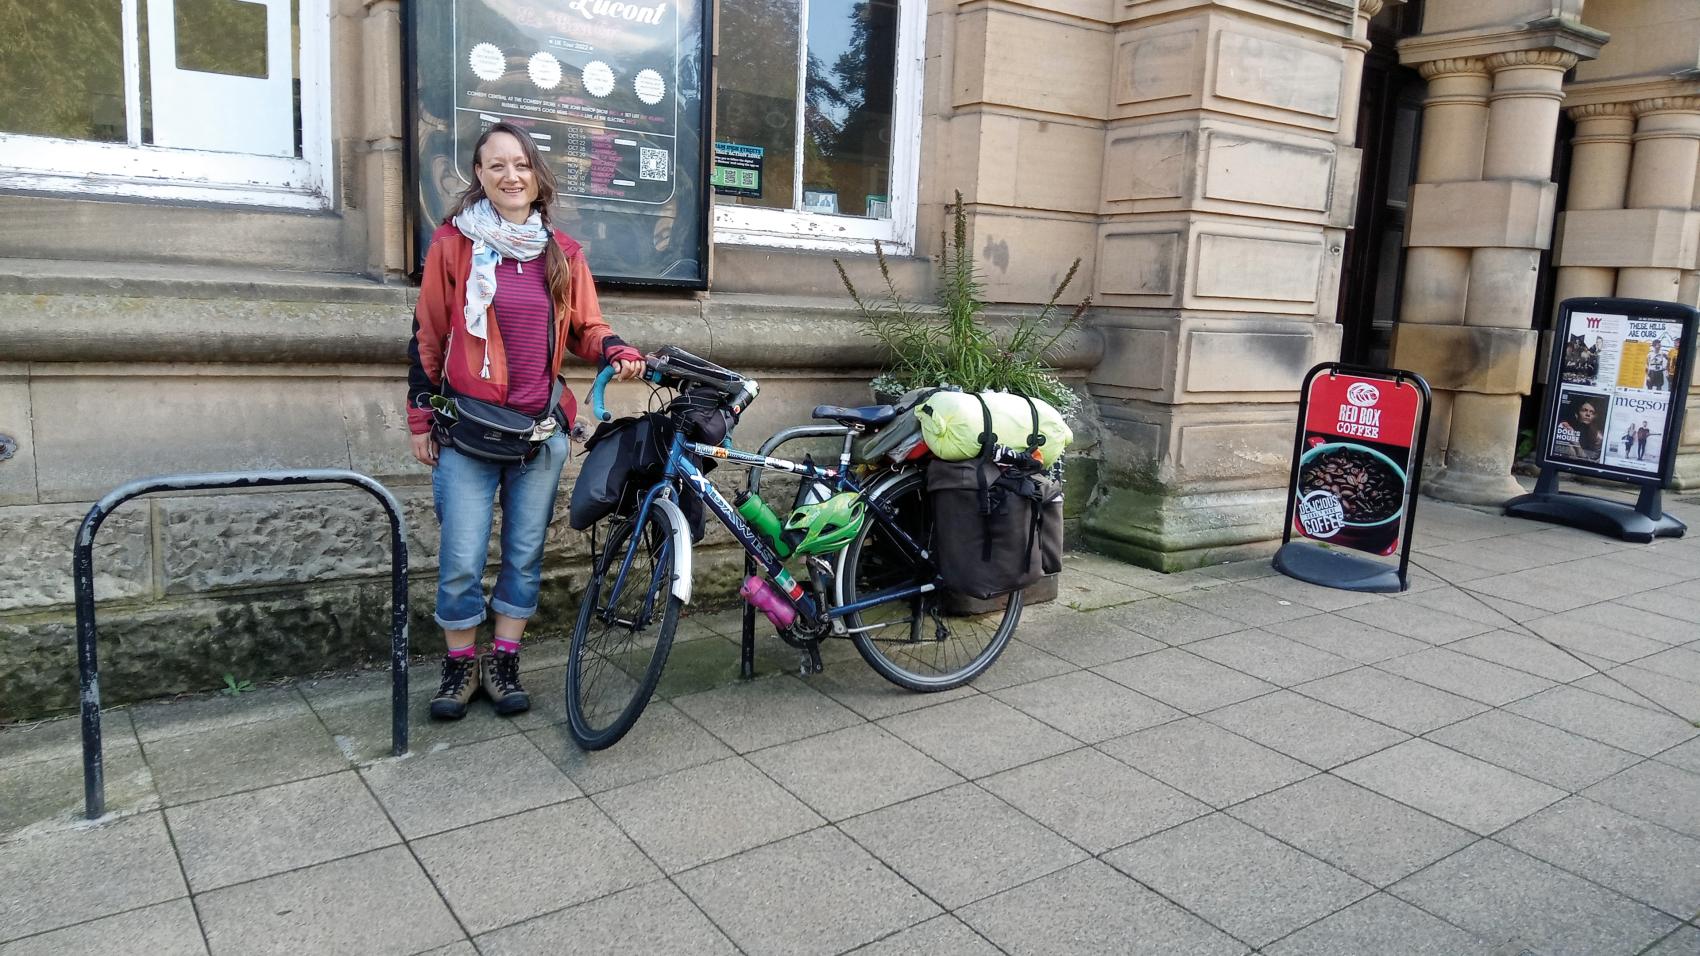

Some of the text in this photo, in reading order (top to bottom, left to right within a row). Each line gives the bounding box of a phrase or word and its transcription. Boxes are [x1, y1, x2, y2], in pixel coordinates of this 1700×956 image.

[467, 90, 487, 98] COMEDY
[488, 93, 507, 101] CENTRAL
[523, 97, 542, 105] COMEDY
[1628, 330, 1640, 338] ARE
[1640, 330, 1657, 338] OURS
[1629, 322, 1666, 331] THESE HILLS
[1338, 404, 1381, 426] RED BOX
[1336, 421, 1379, 439] COFFEE
[1556, 434, 1580, 442] HOUSE
[1557, 428, 1581, 437] DOLL'S
[1299, 495, 1339, 514] DELICIOUS
[709, 486, 774, 565] DAWES
[1304, 512, 1346, 535] COFFEE
